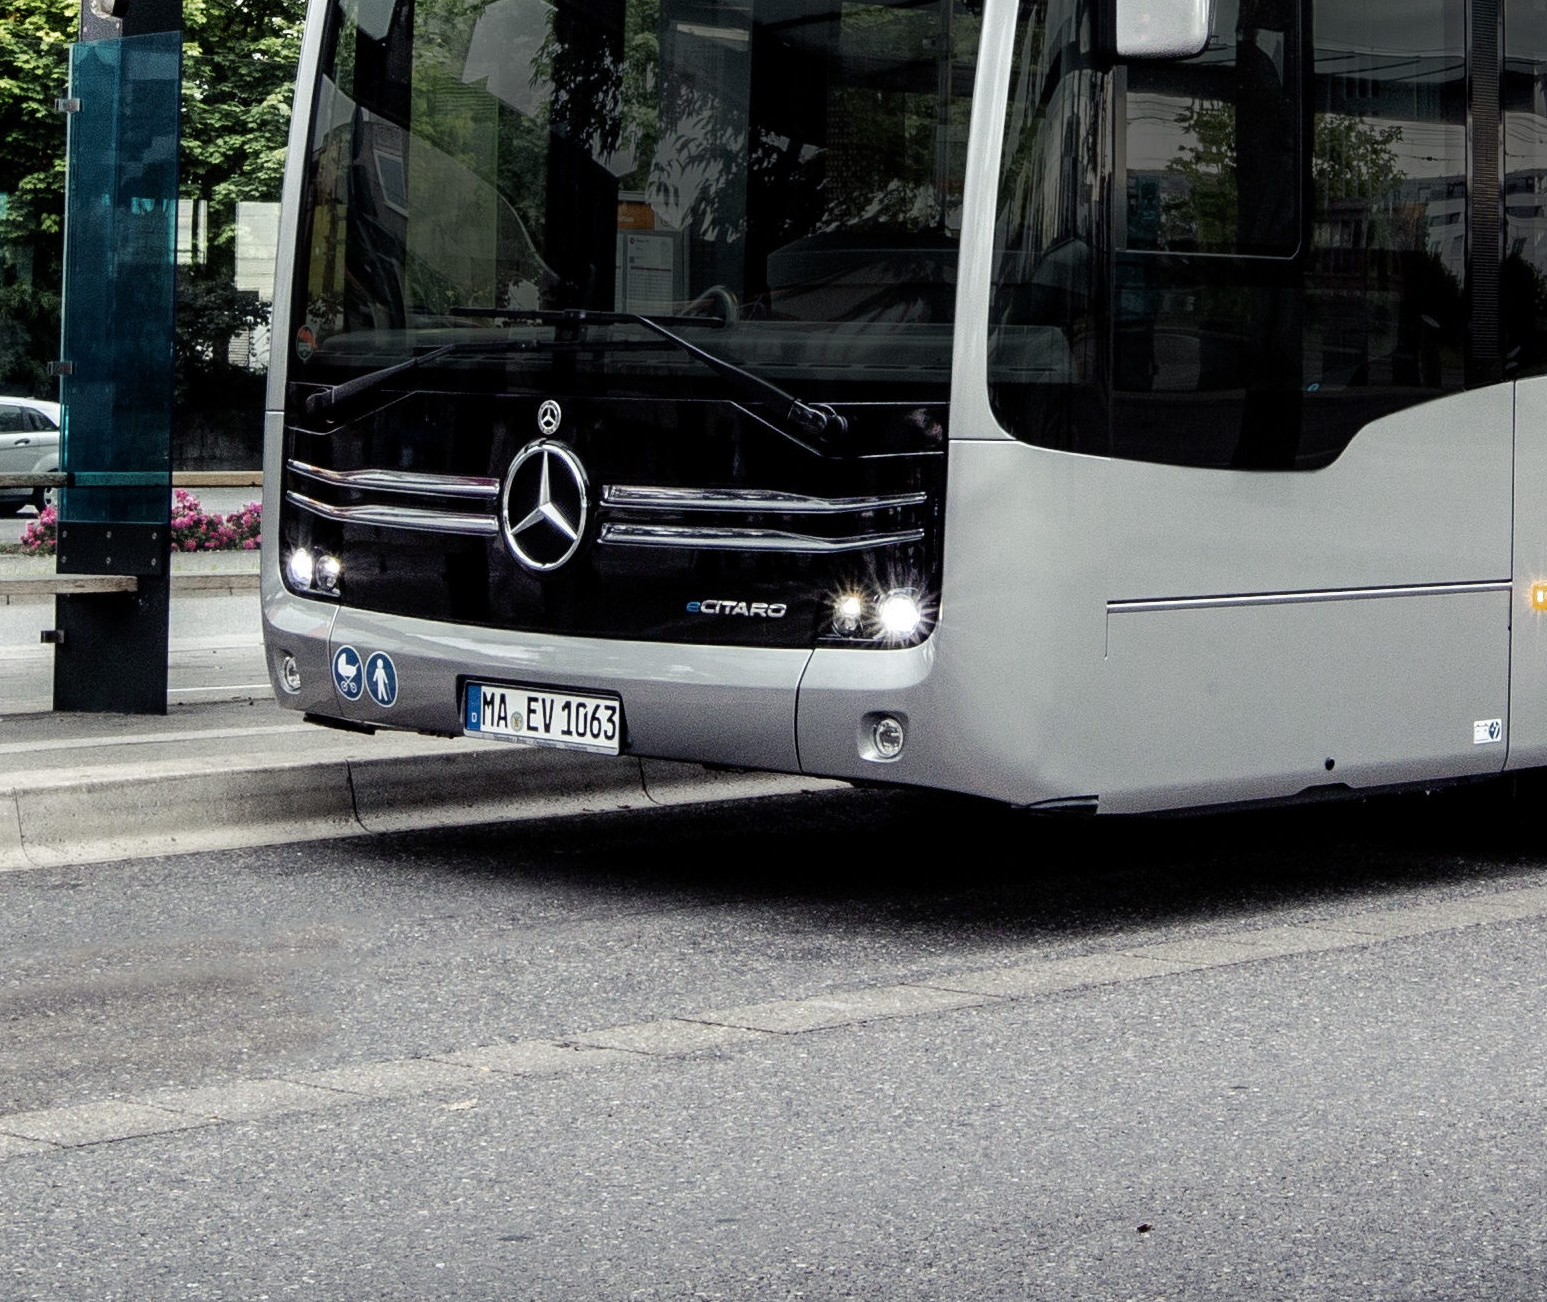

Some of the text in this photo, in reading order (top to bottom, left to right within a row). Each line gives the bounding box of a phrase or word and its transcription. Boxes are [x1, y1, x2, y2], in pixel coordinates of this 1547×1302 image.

[686, 599, 787, 618] eCITARO
[471, 712, 477, 723] D
[482, 691, 617, 740] MA EV 1063
